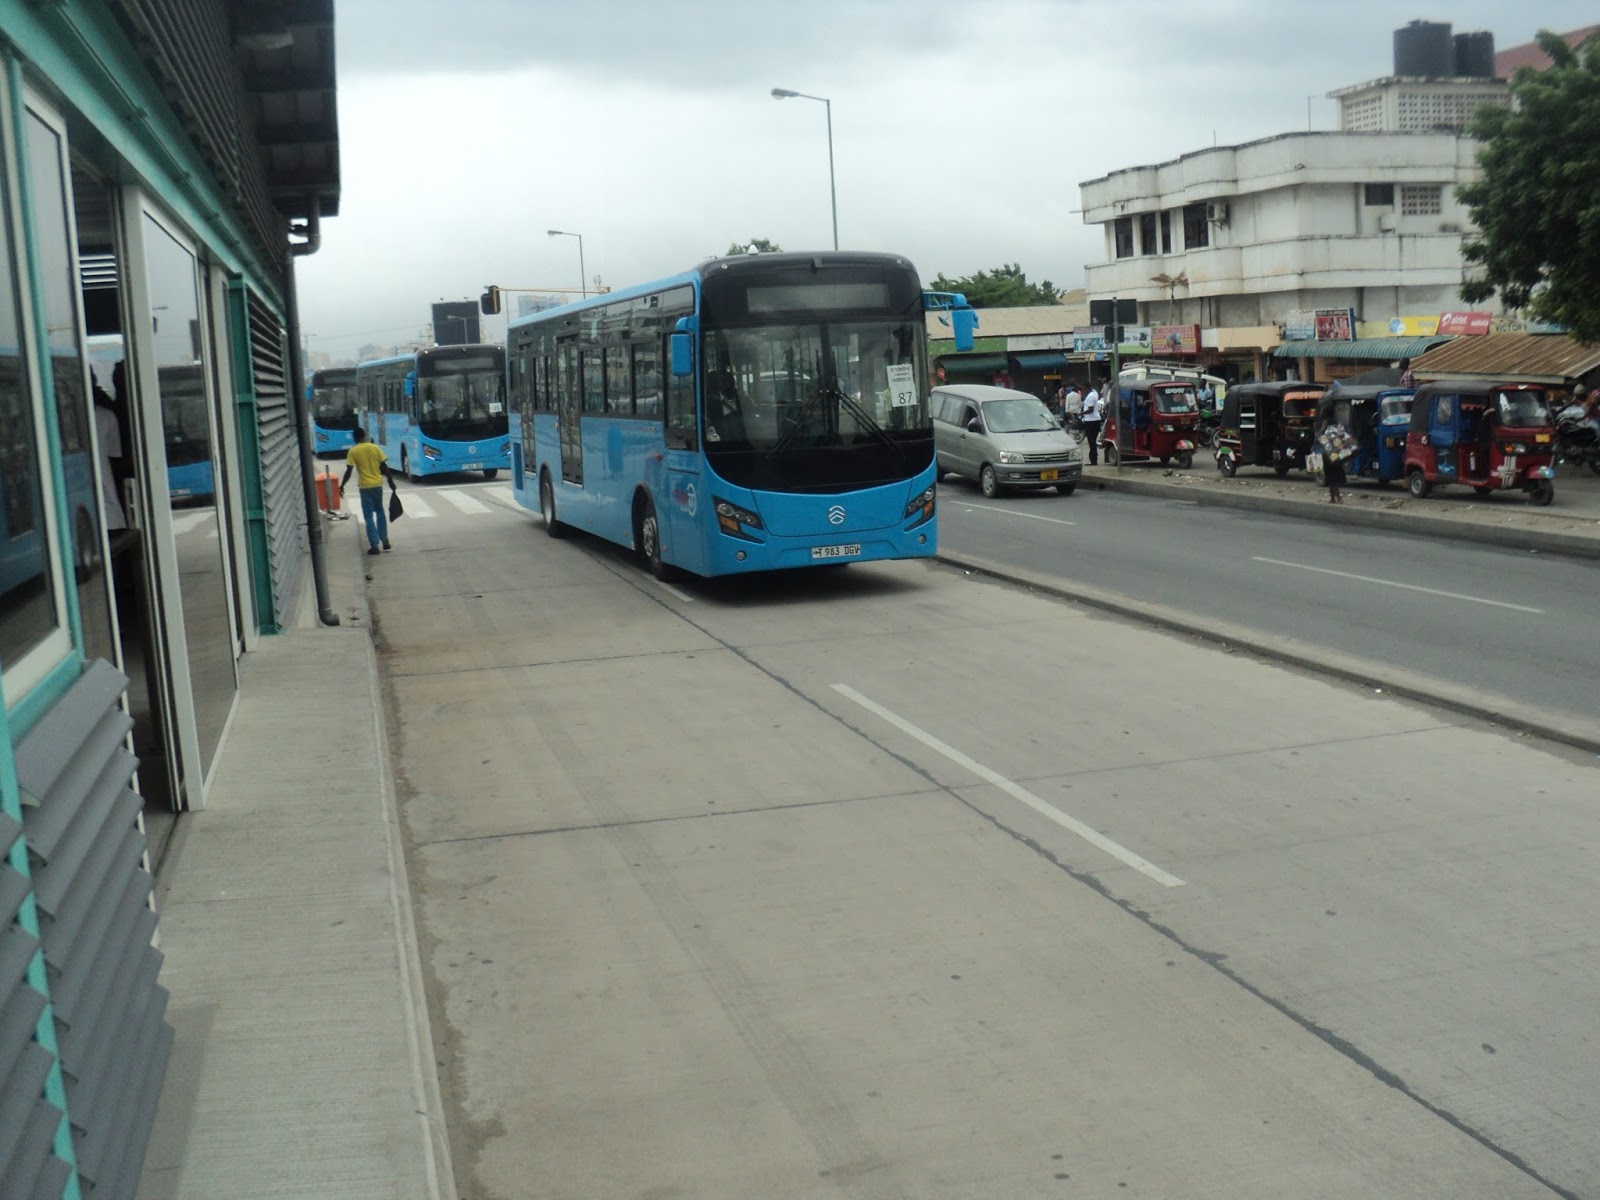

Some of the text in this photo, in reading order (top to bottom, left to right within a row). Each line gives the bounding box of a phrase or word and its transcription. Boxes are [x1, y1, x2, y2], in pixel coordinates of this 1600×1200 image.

[898, 391, 912, 404] 87
[825, 547, 840, 556] 983
[844, 545, 859, 555] DGV
